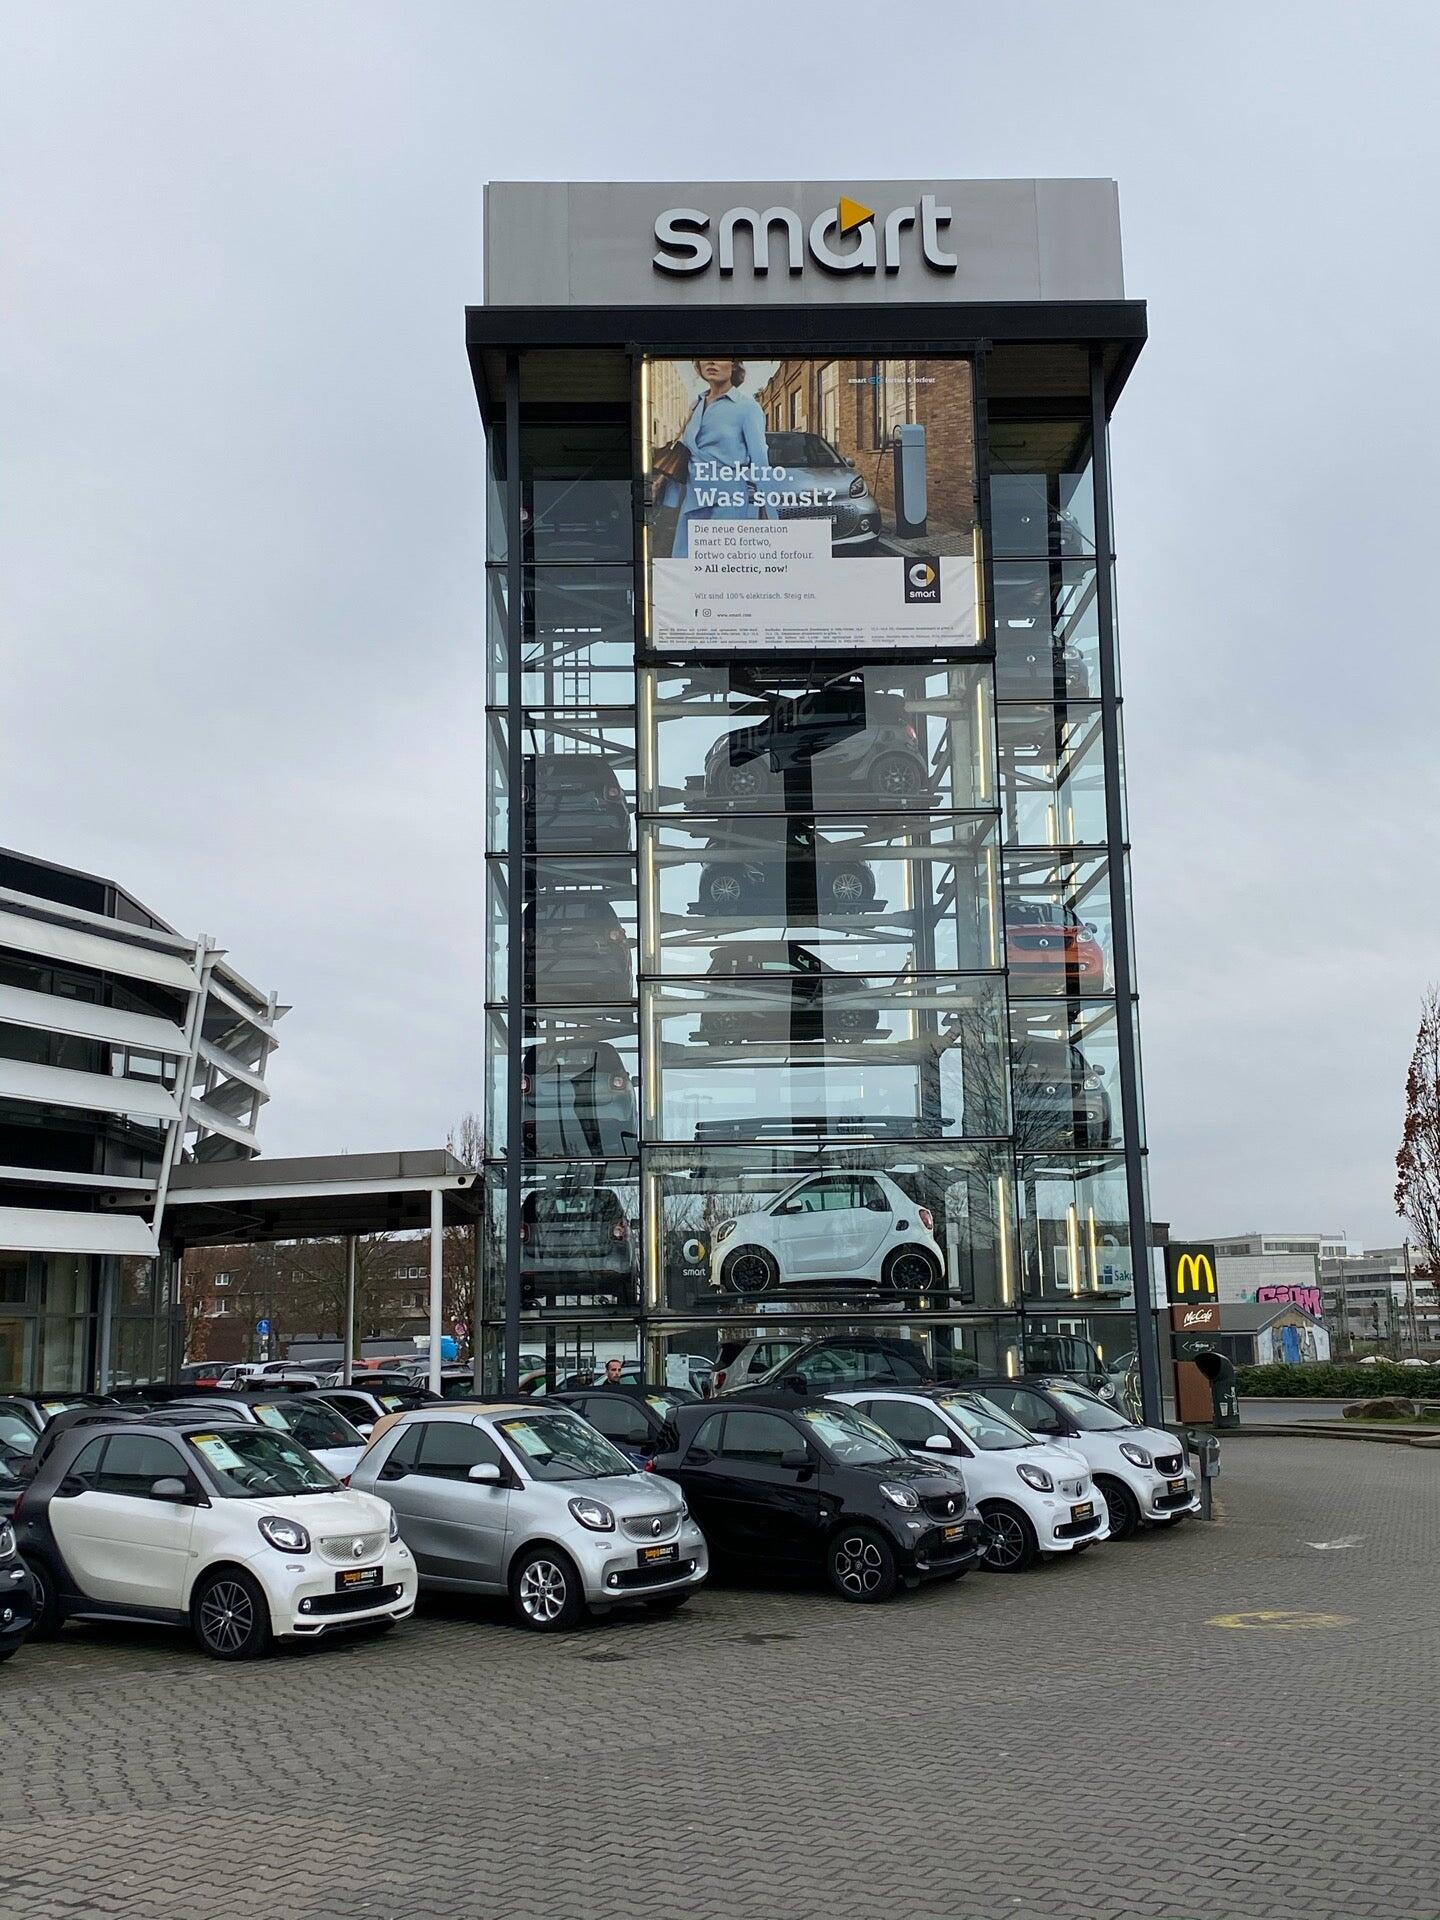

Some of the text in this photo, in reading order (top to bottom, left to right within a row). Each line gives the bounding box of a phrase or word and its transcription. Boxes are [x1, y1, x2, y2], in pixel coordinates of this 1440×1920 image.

[653, 195, 957, 275] smart
[694, 461, 794, 481] Elektro.
[694, 487, 837, 507] Was sonst?
[694, 525, 709, 533] Die
[737, 525, 788, 533] Generation
[694, 538, 771, 547] smart EQ fortwo,
[694, 551, 815, 559] fortwo cabrio und forfour.
[721, 565, 761, 574] electric,
[909, 590, 936, 598] smart
[683, 1268, 706, 1276] smart
